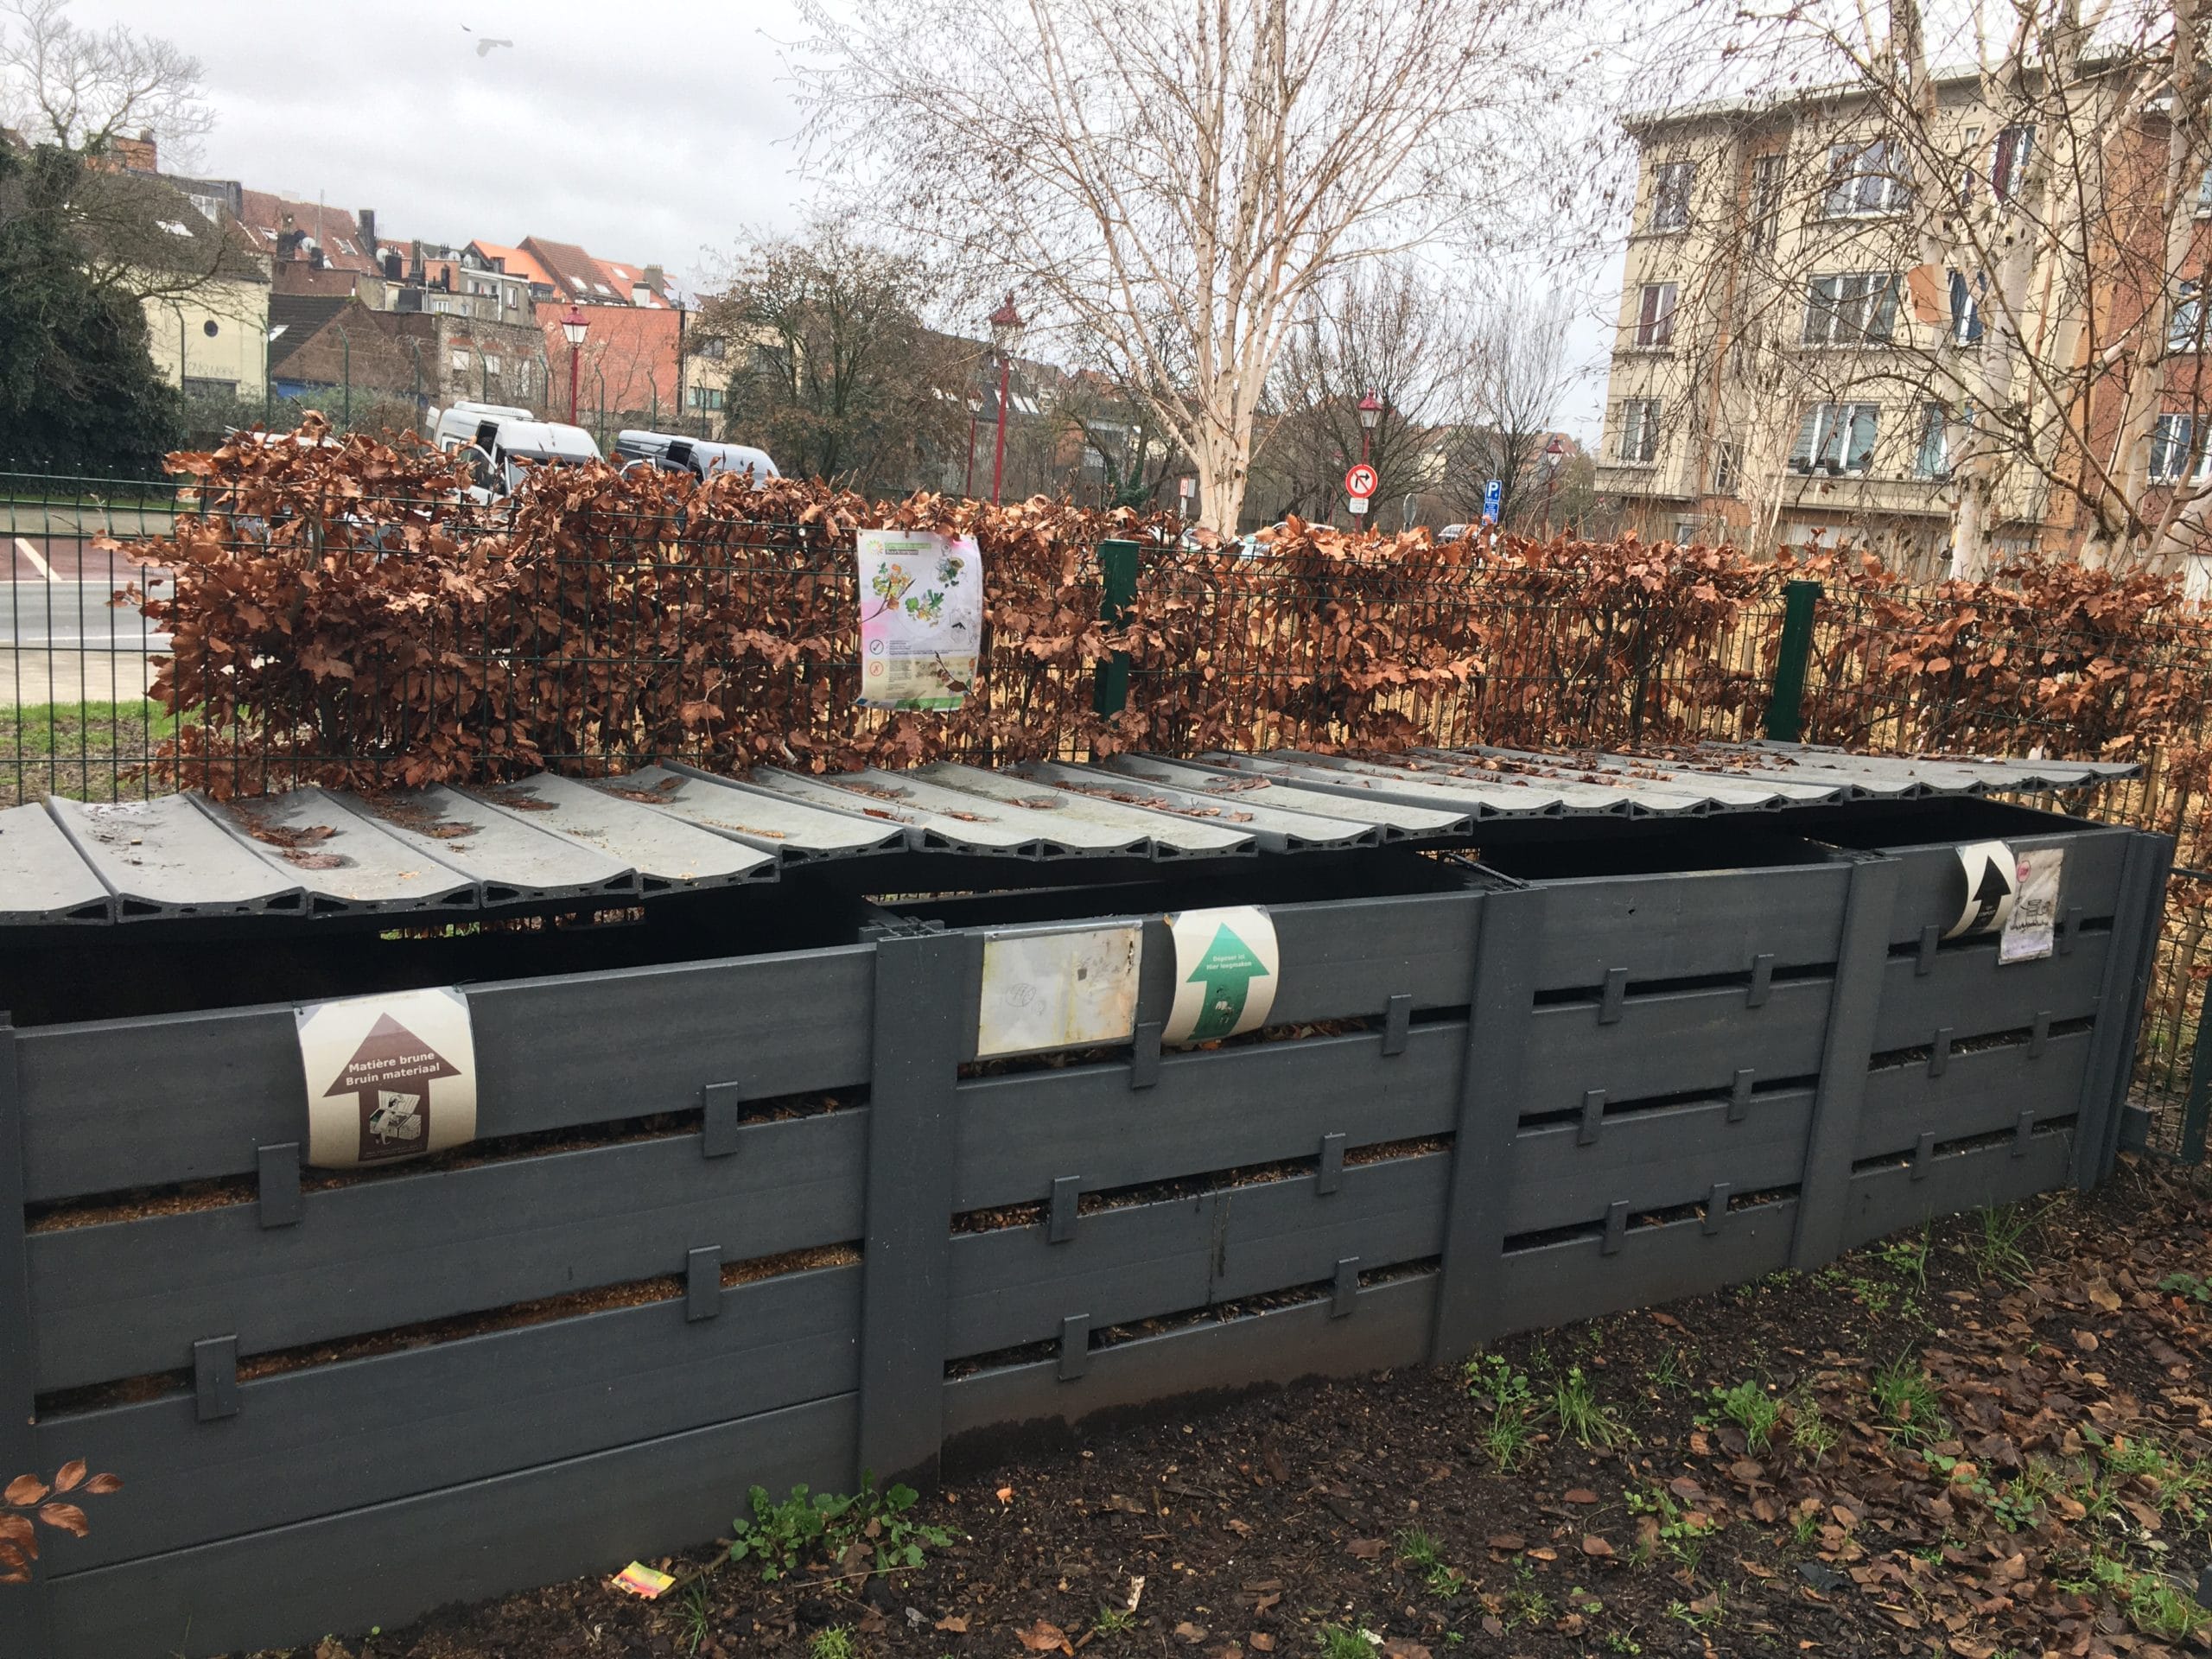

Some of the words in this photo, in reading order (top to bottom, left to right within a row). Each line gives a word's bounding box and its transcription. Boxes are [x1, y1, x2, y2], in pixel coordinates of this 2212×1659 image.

[1487, 481, 1499, 497] P
[348, 1058, 397, 1073] Matière
[399, 1052, 435, 1065] brune
[346, 1073, 378, 1086] Bruin
[383, 1062, 441, 1080] materiaal
